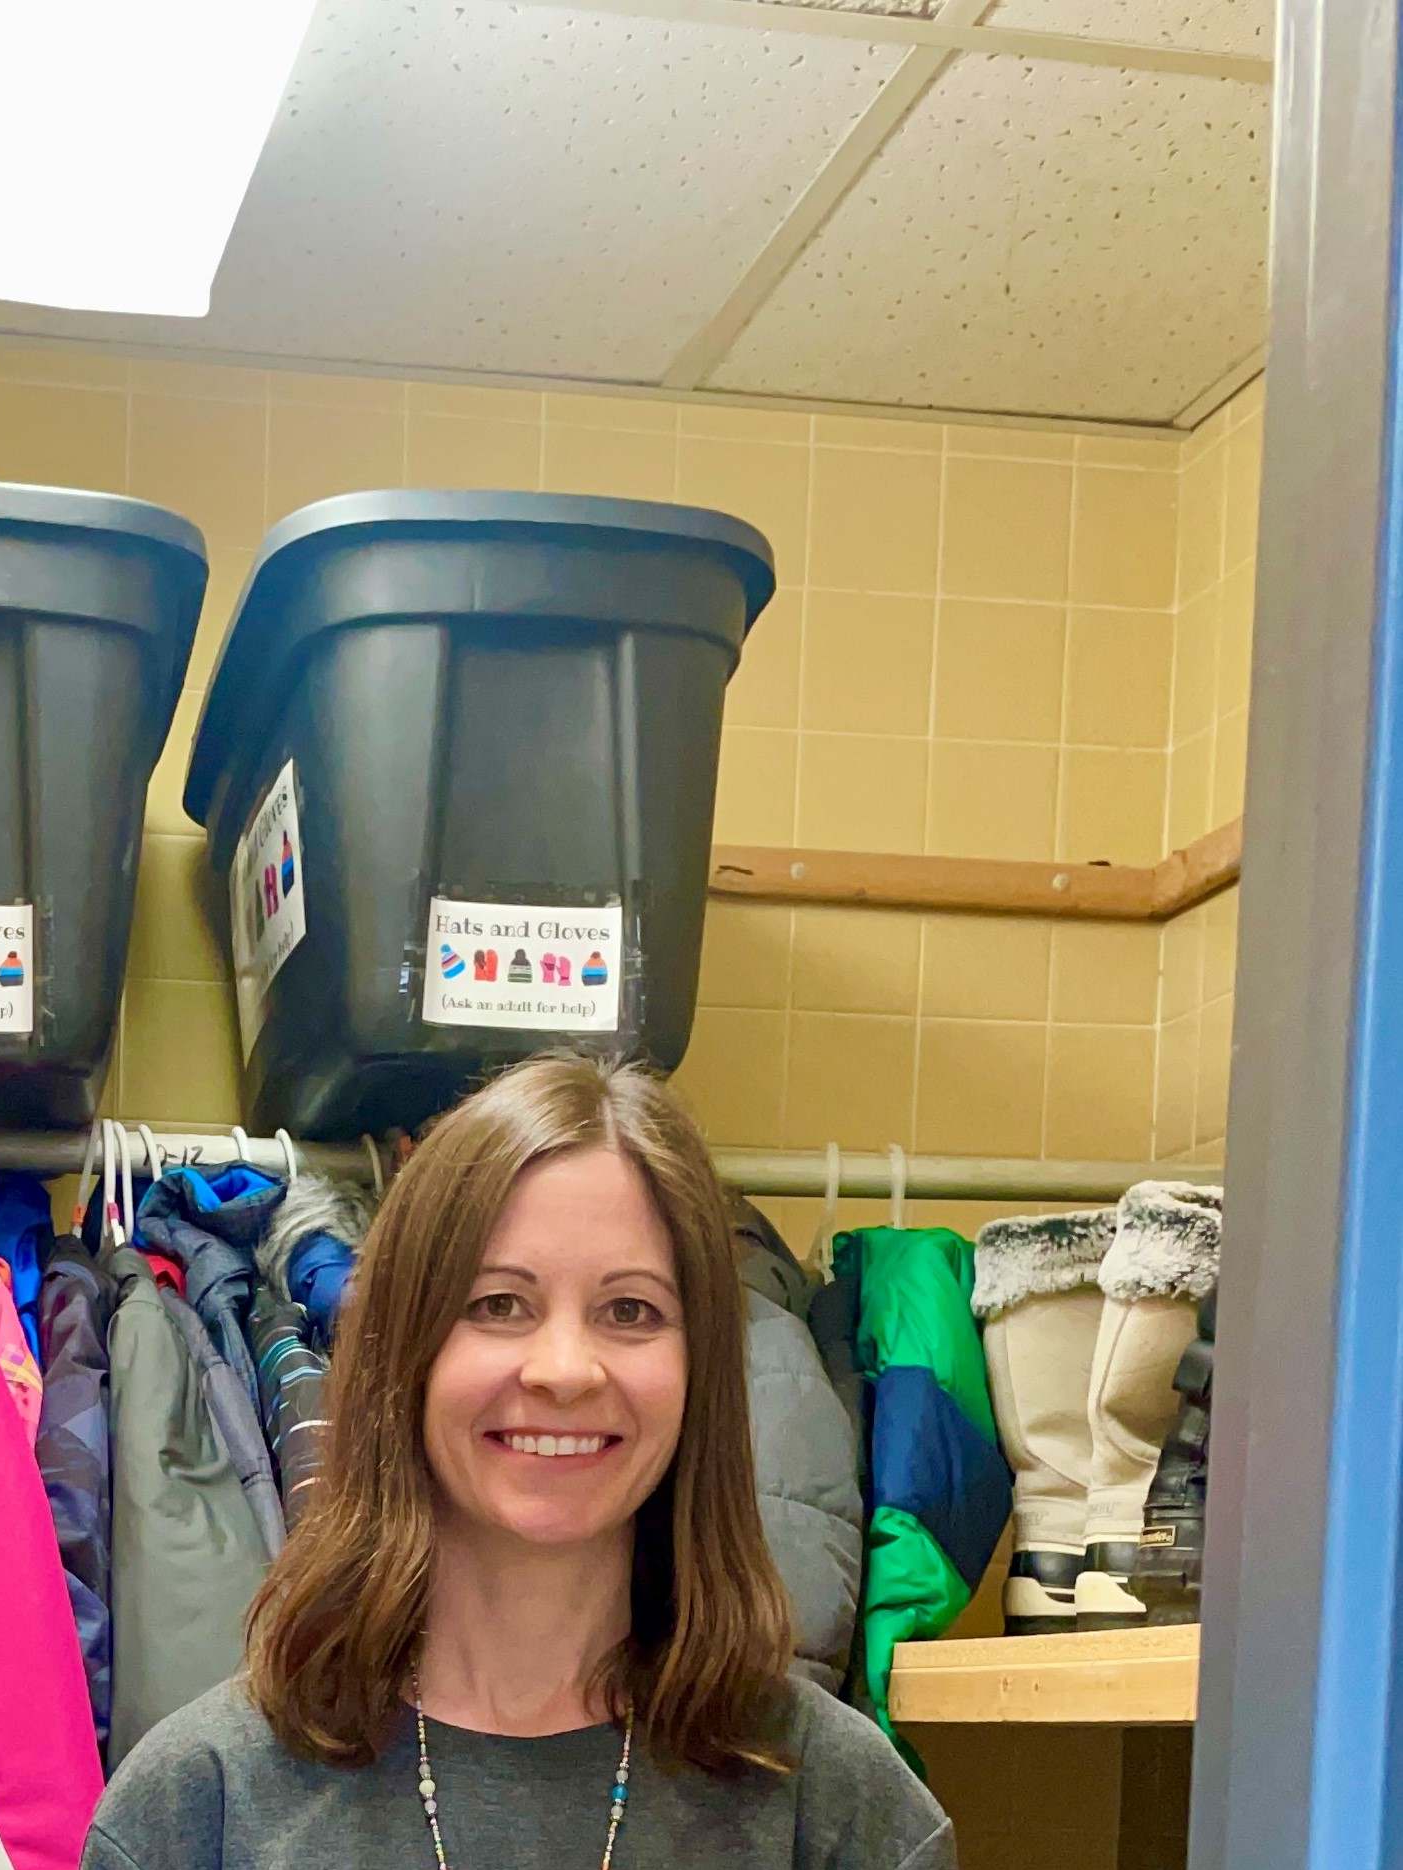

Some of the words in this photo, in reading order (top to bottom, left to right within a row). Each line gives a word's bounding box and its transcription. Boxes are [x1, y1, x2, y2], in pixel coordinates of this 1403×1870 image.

[435, 914, 484, 936] Hats
[490, 921, 531, 938] and
[537, 921, 611, 941] Gloves
[442, 994, 473, 1011] (Ask
[477, 1001, 493, 1010] an
[497, 1001, 532, 1012] adult
[537, 1001, 558, 1014] for
[562, 1001, 596, 1017] help)
